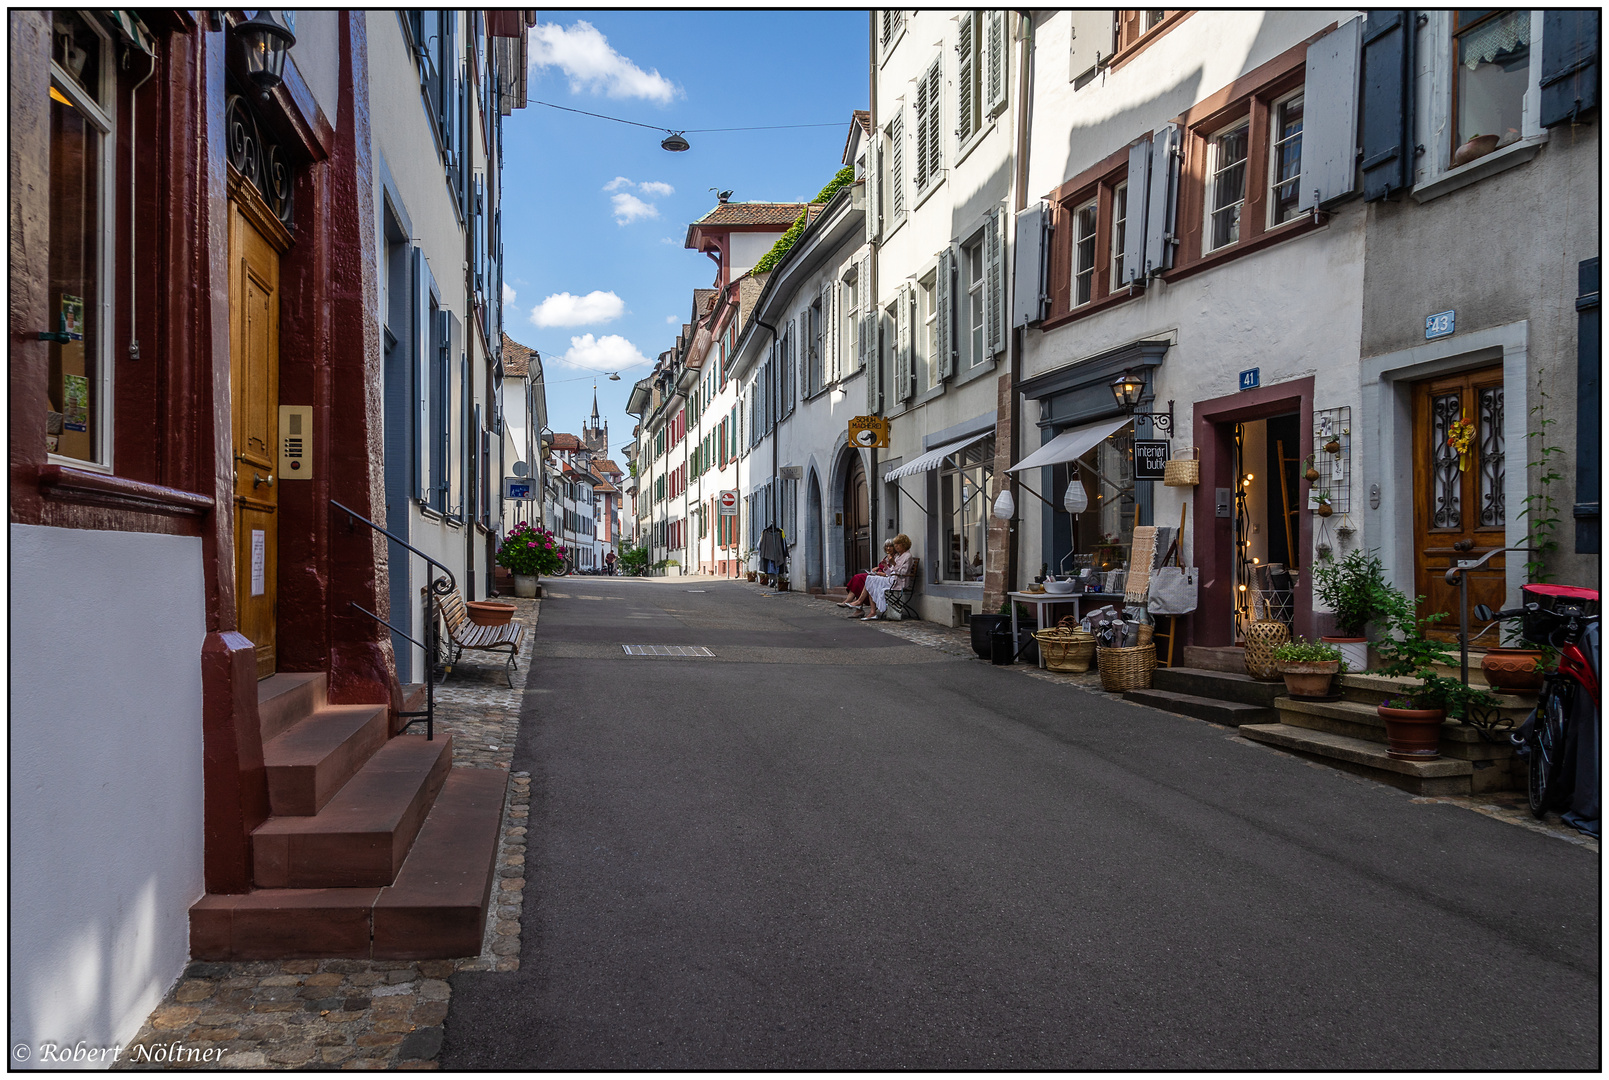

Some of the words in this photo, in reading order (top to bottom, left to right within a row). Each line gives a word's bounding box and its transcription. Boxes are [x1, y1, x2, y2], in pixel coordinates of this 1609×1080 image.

[1431, 316, 1448, 332] 43
[1244, 372, 1254, 385] 41
[1146, 457, 1166, 470] butik
